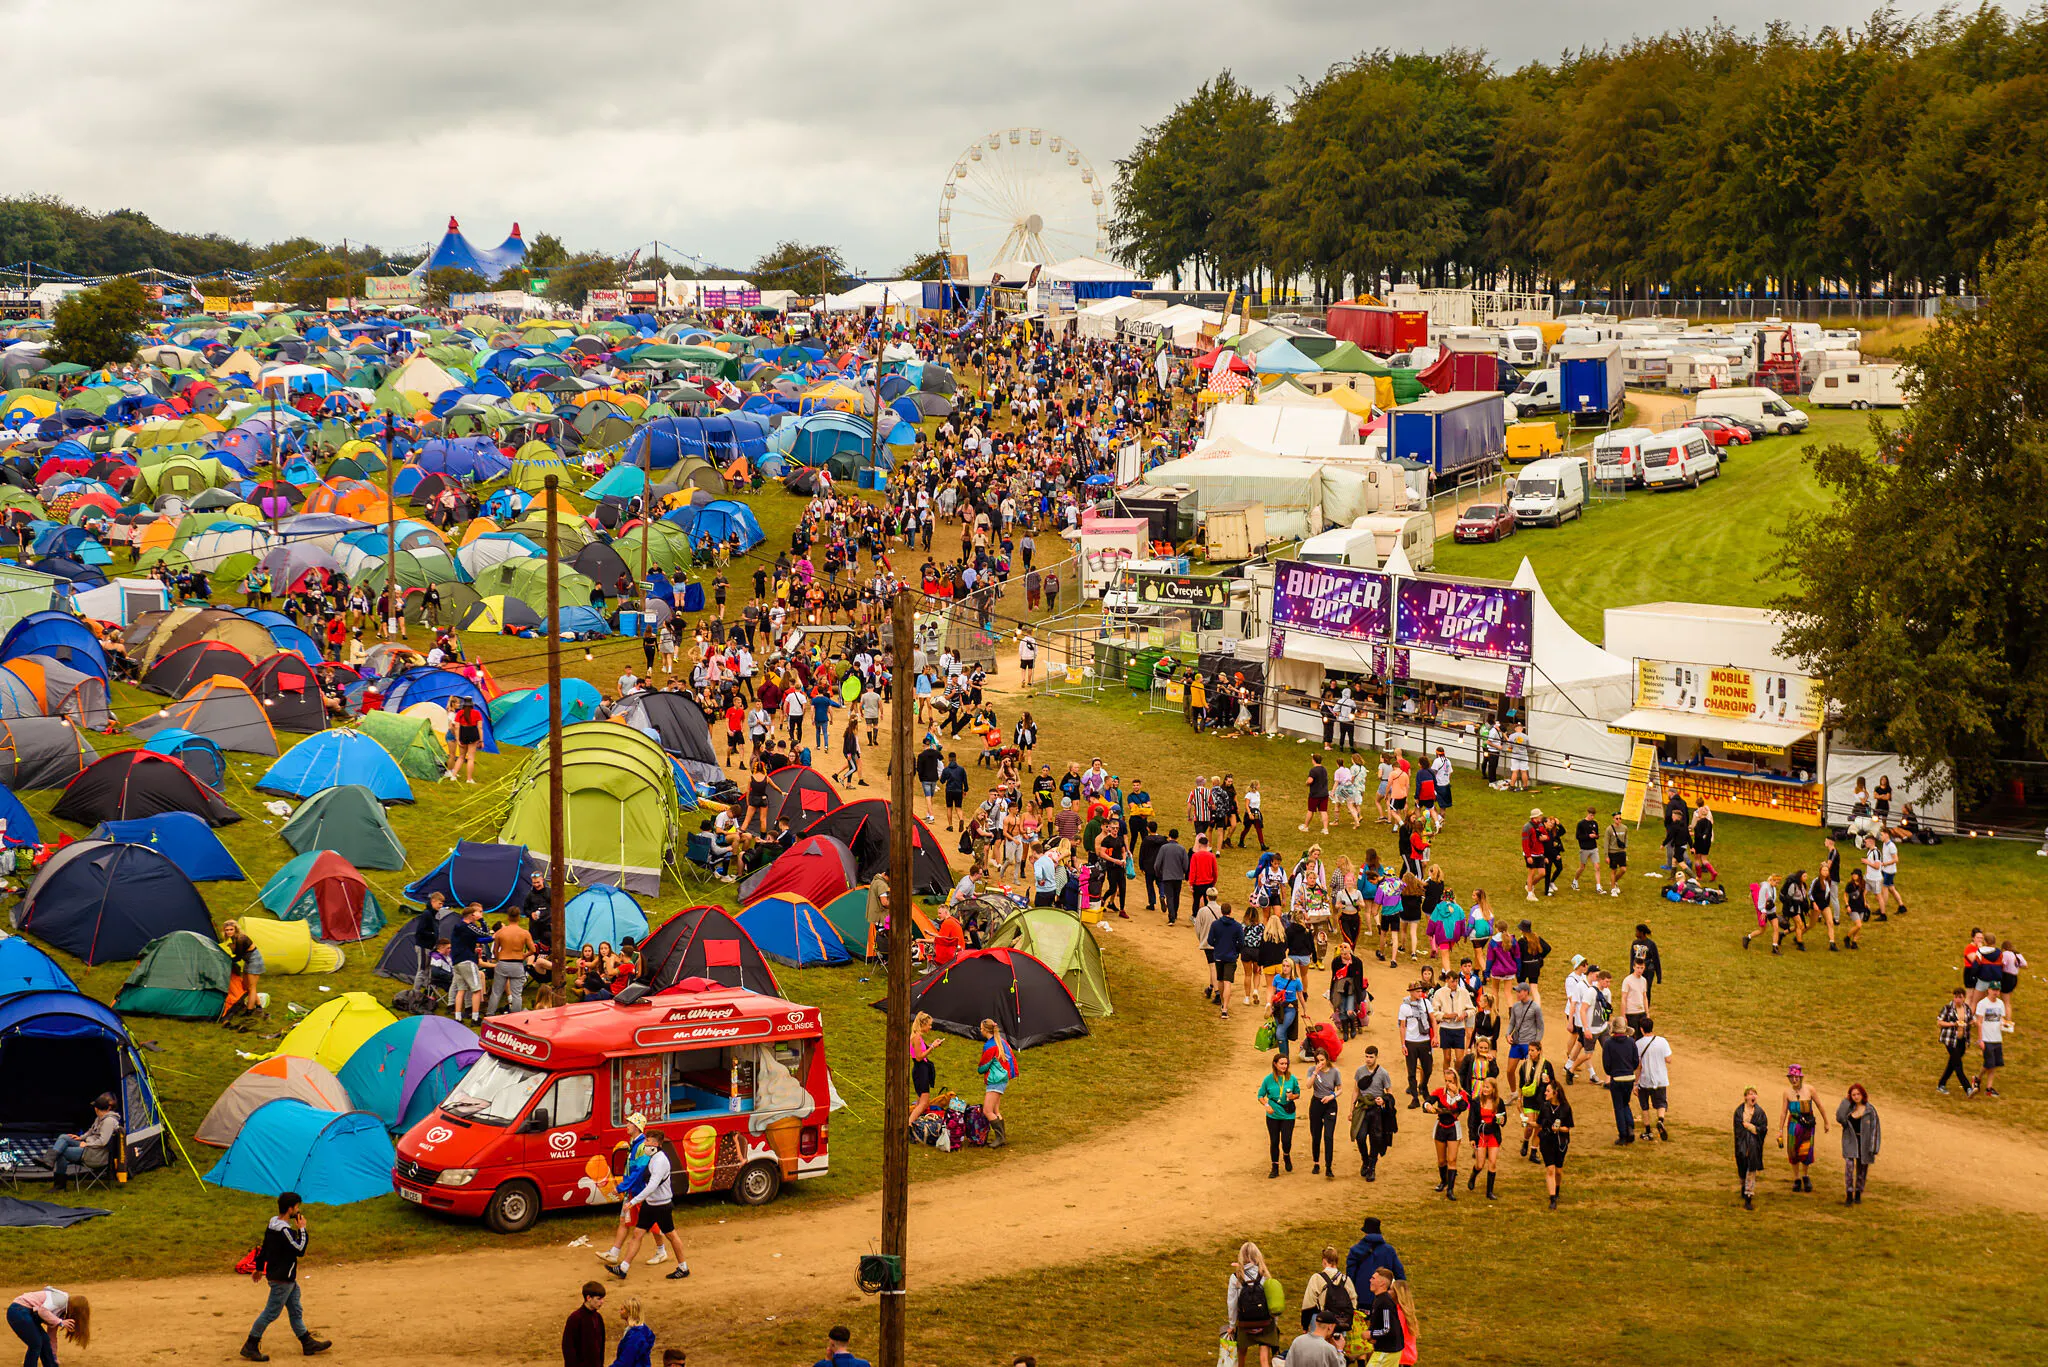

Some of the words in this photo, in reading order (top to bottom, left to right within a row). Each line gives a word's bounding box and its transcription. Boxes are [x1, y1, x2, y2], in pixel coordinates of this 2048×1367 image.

[1179, 585, 1203, 598] recycle
[1286, 569, 1382, 609] BURGER
[1310, 597, 1353, 624] BAR
[1428, 588, 1504, 624] PIZZA
[1440, 614, 1488, 643] BAR
[1711, 671, 1750, 684] MOBILE
[1644, 687, 1665, 695] Samsung
[1713, 685, 1748, 698] PHONE
[1704, 698, 1756, 713] CHARGING
[1726, 742, 1745, 750] PHONE
[1696, 774, 1730, 803] YOUR
[1734, 778, 1780, 809] PHONE
[1782, 784, 1820, 815] HERE
[669, 1013, 686, 1021] Mr.
[687, 1008, 734, 1020] Whippy
[673, 1031, 690, 1039] Mr.
[691, 1027, 739, 1037] Whippy
[777, 1024, 794, 1032] COOL
[794, 1021, 814, 1030] INSIDE
[485, 1029, 496, 1041] Mr.
[496, 1031, 537, 1055] Whippy
[418, 1142, 435, 1152] WALL'S
[550, 1150, 576, 1159] WALL'S
